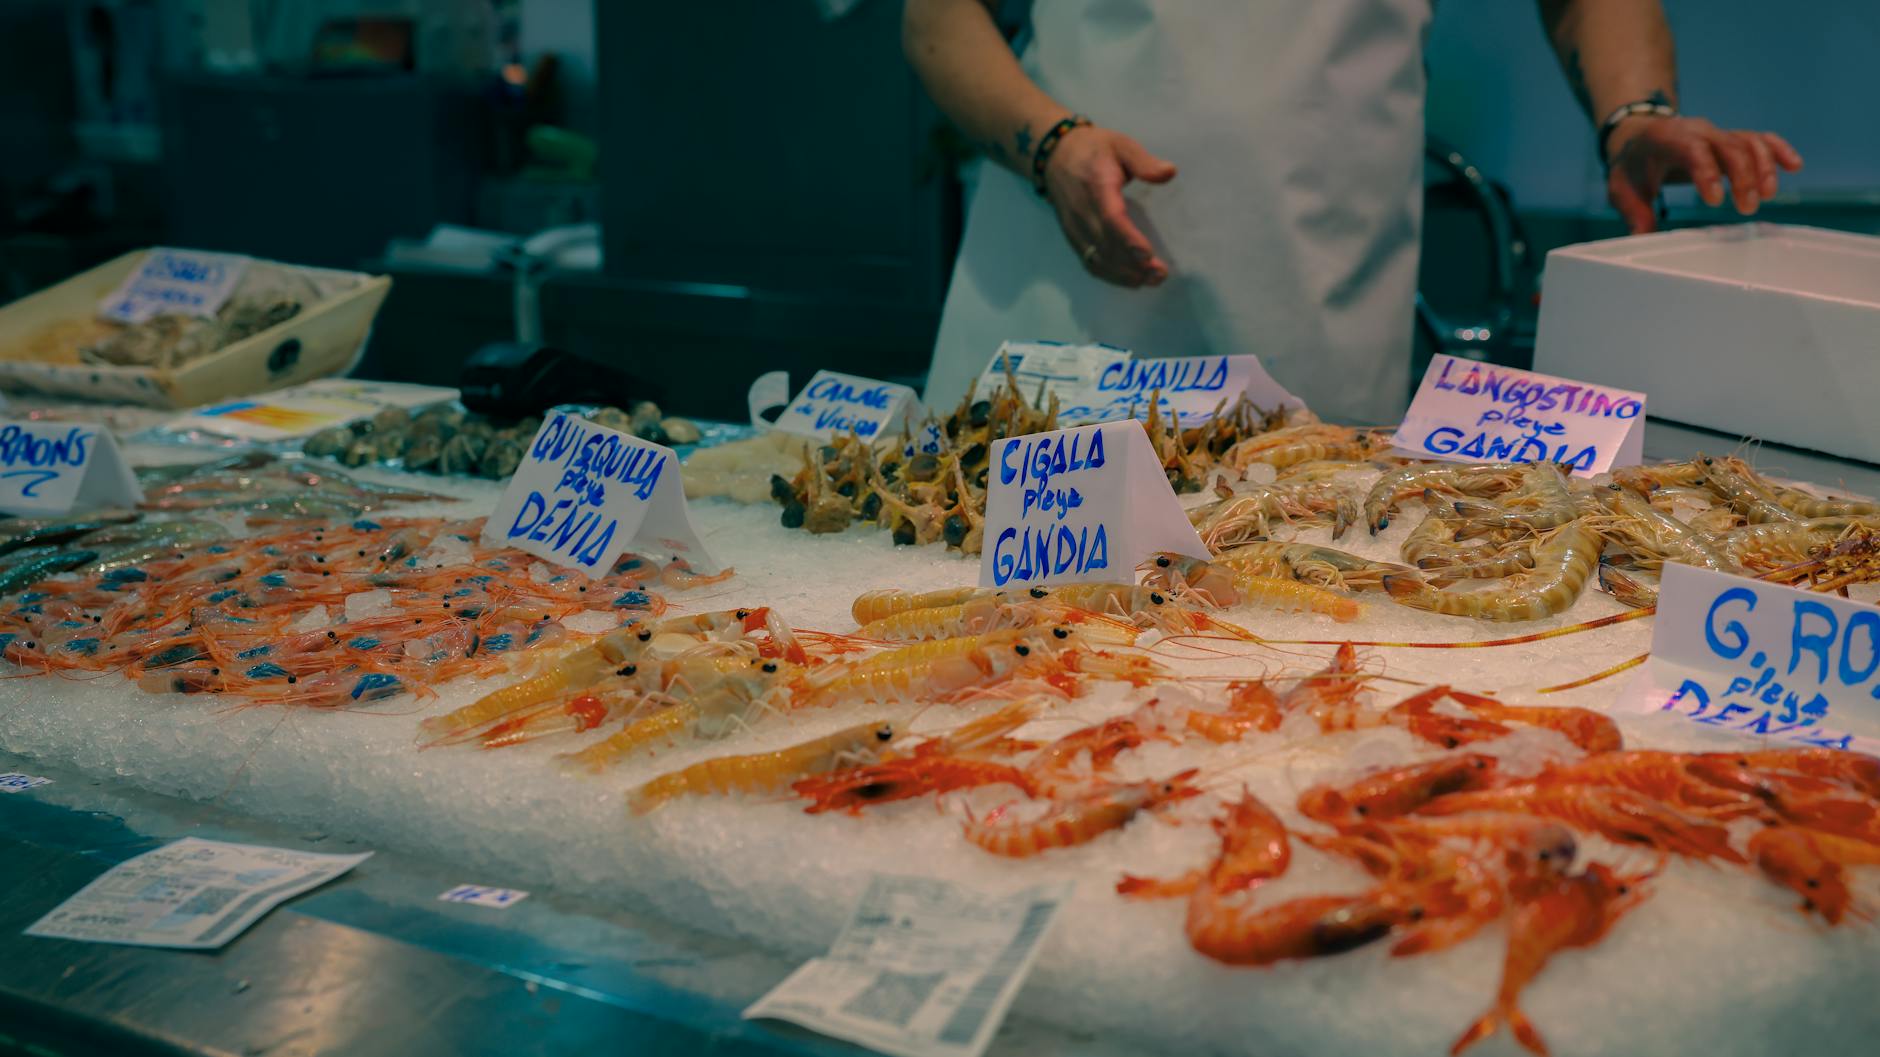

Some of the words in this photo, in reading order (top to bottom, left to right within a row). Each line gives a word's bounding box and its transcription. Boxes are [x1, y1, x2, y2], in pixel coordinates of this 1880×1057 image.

[1098, 356, 1228, 391] CANAILLA
[1435, 359, 1642, 419] LANGOSTINO
[532, 415, 666, 500] QUISQUILLA
[1001, 428, 1105, 488] CIGALA
[1423, 427, 1597, 471] GANDIA
[508, 491, 617, 567] DENIA
[993, 524, 1108, 587] GANDIA
[1788, 600, 1880, 700] RO
